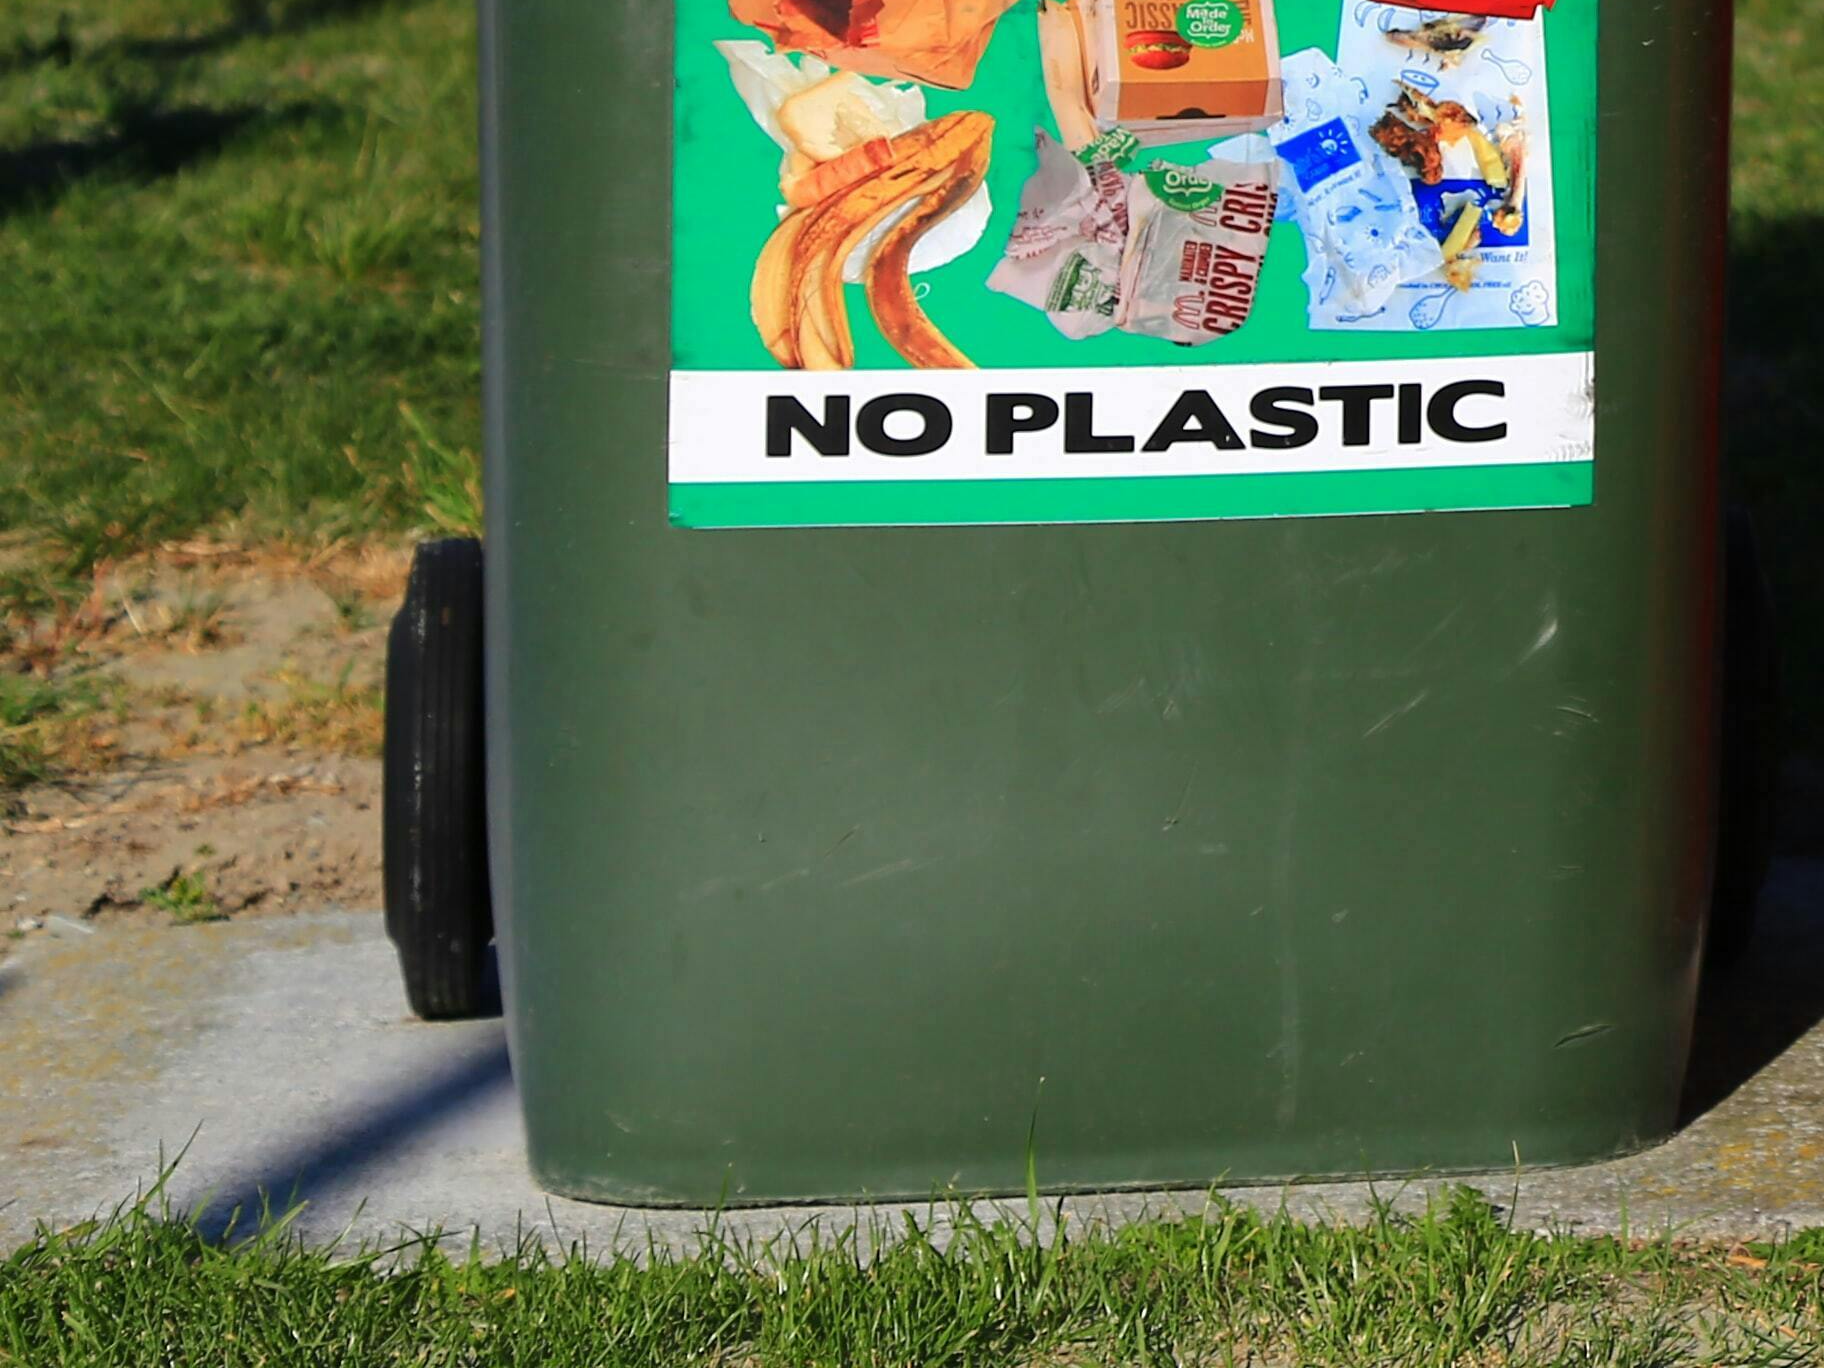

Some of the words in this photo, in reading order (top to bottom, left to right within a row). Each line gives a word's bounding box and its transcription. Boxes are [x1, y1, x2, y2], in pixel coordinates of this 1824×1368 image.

[1186, 8, 1228, 20] Made
[1190, 20, 1232, 34] Order
[1480, 250, 1512, 263] Want
[1202, 244, 1258, 335] CRISPY
[764, 390, 954, 459] NO
[984, 379, 1509, 457] PLASTIC
